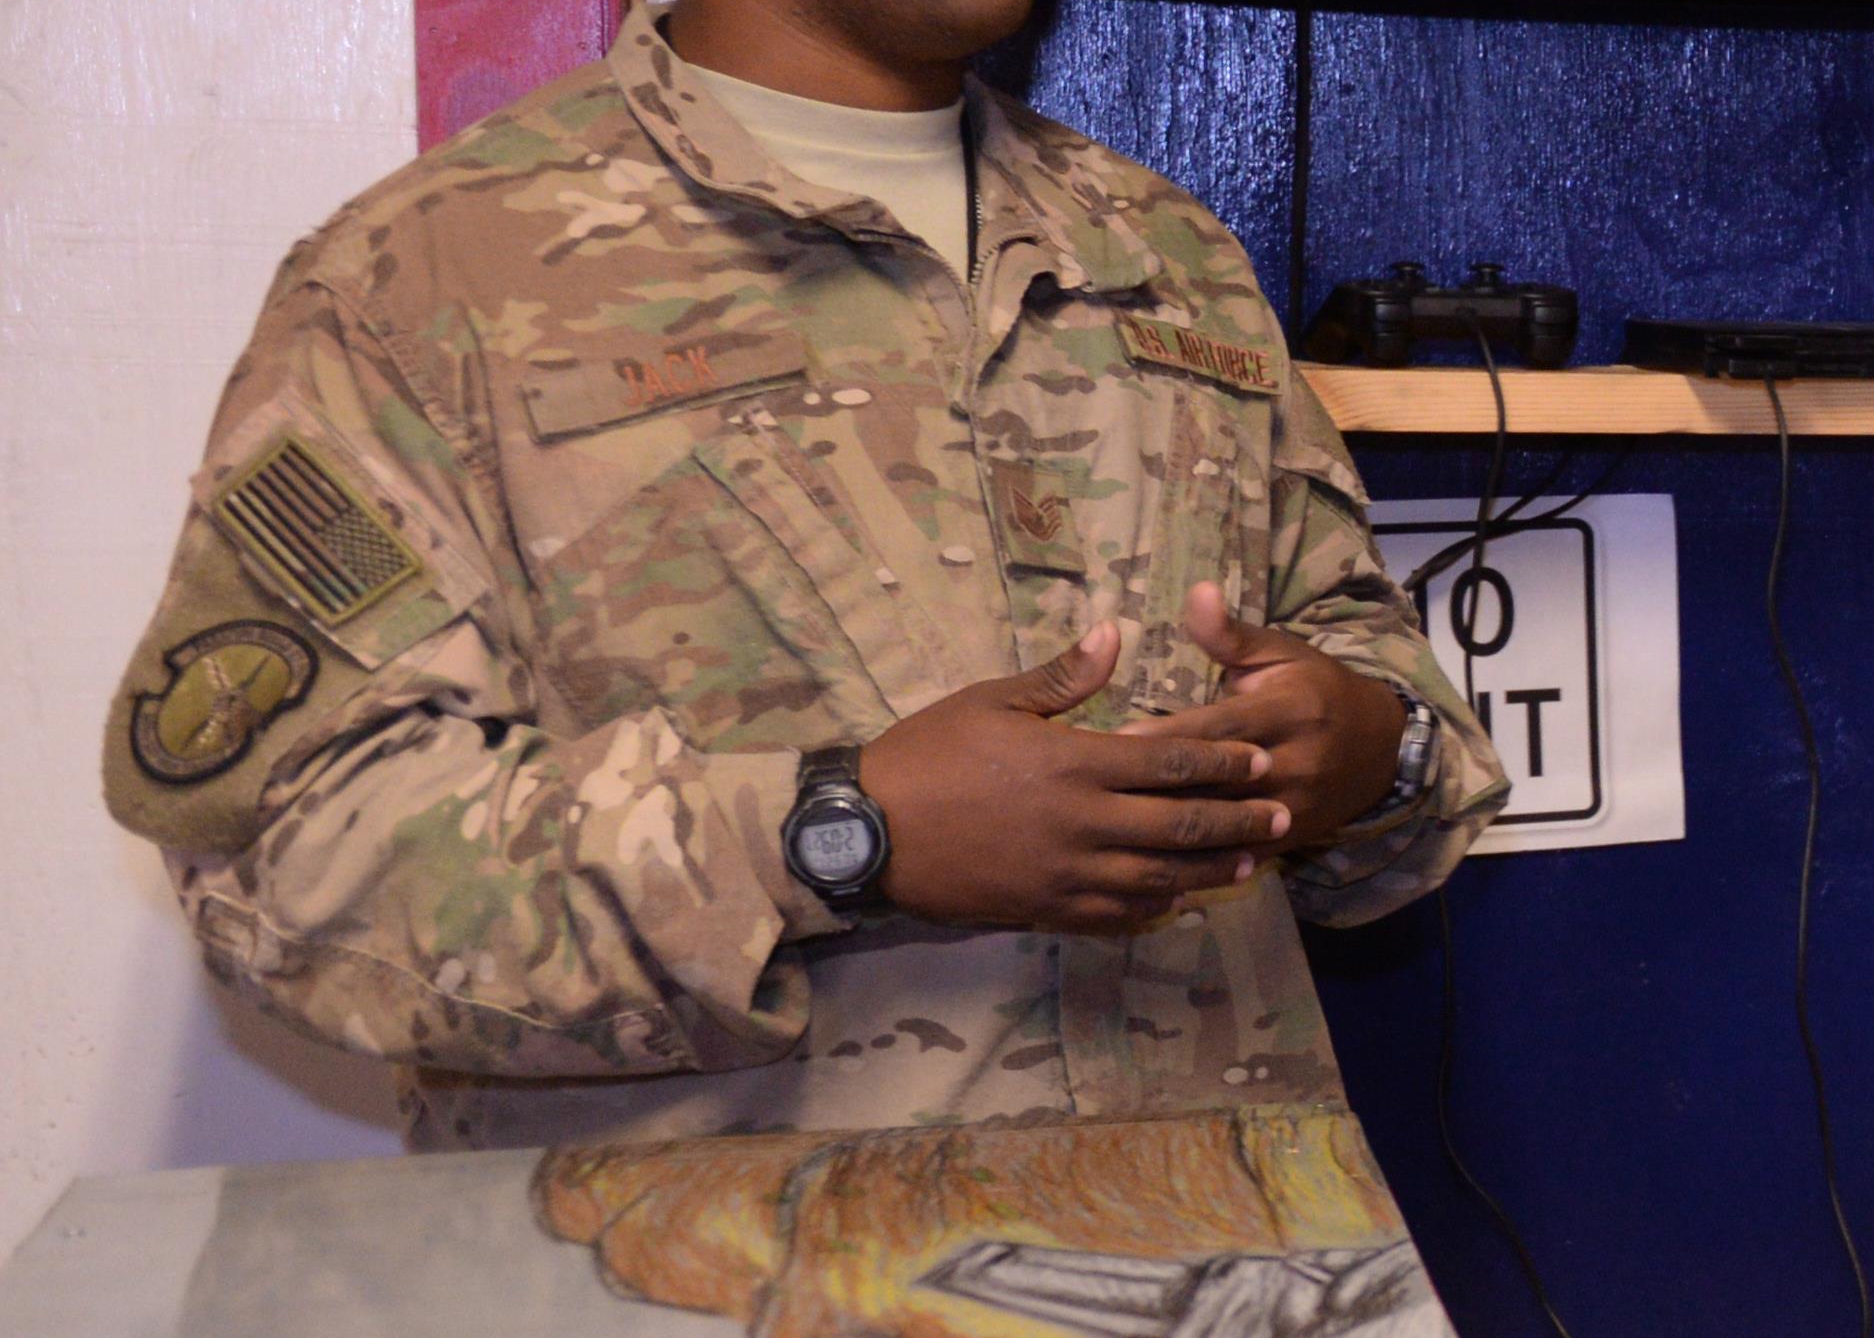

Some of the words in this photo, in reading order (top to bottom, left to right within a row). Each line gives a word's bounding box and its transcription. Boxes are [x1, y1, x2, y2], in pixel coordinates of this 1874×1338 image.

[623, 345, 718, 406] JACK
[1173, 328, 1210, 369] AIR
[1205, 339, 1279, 388] FORCE
